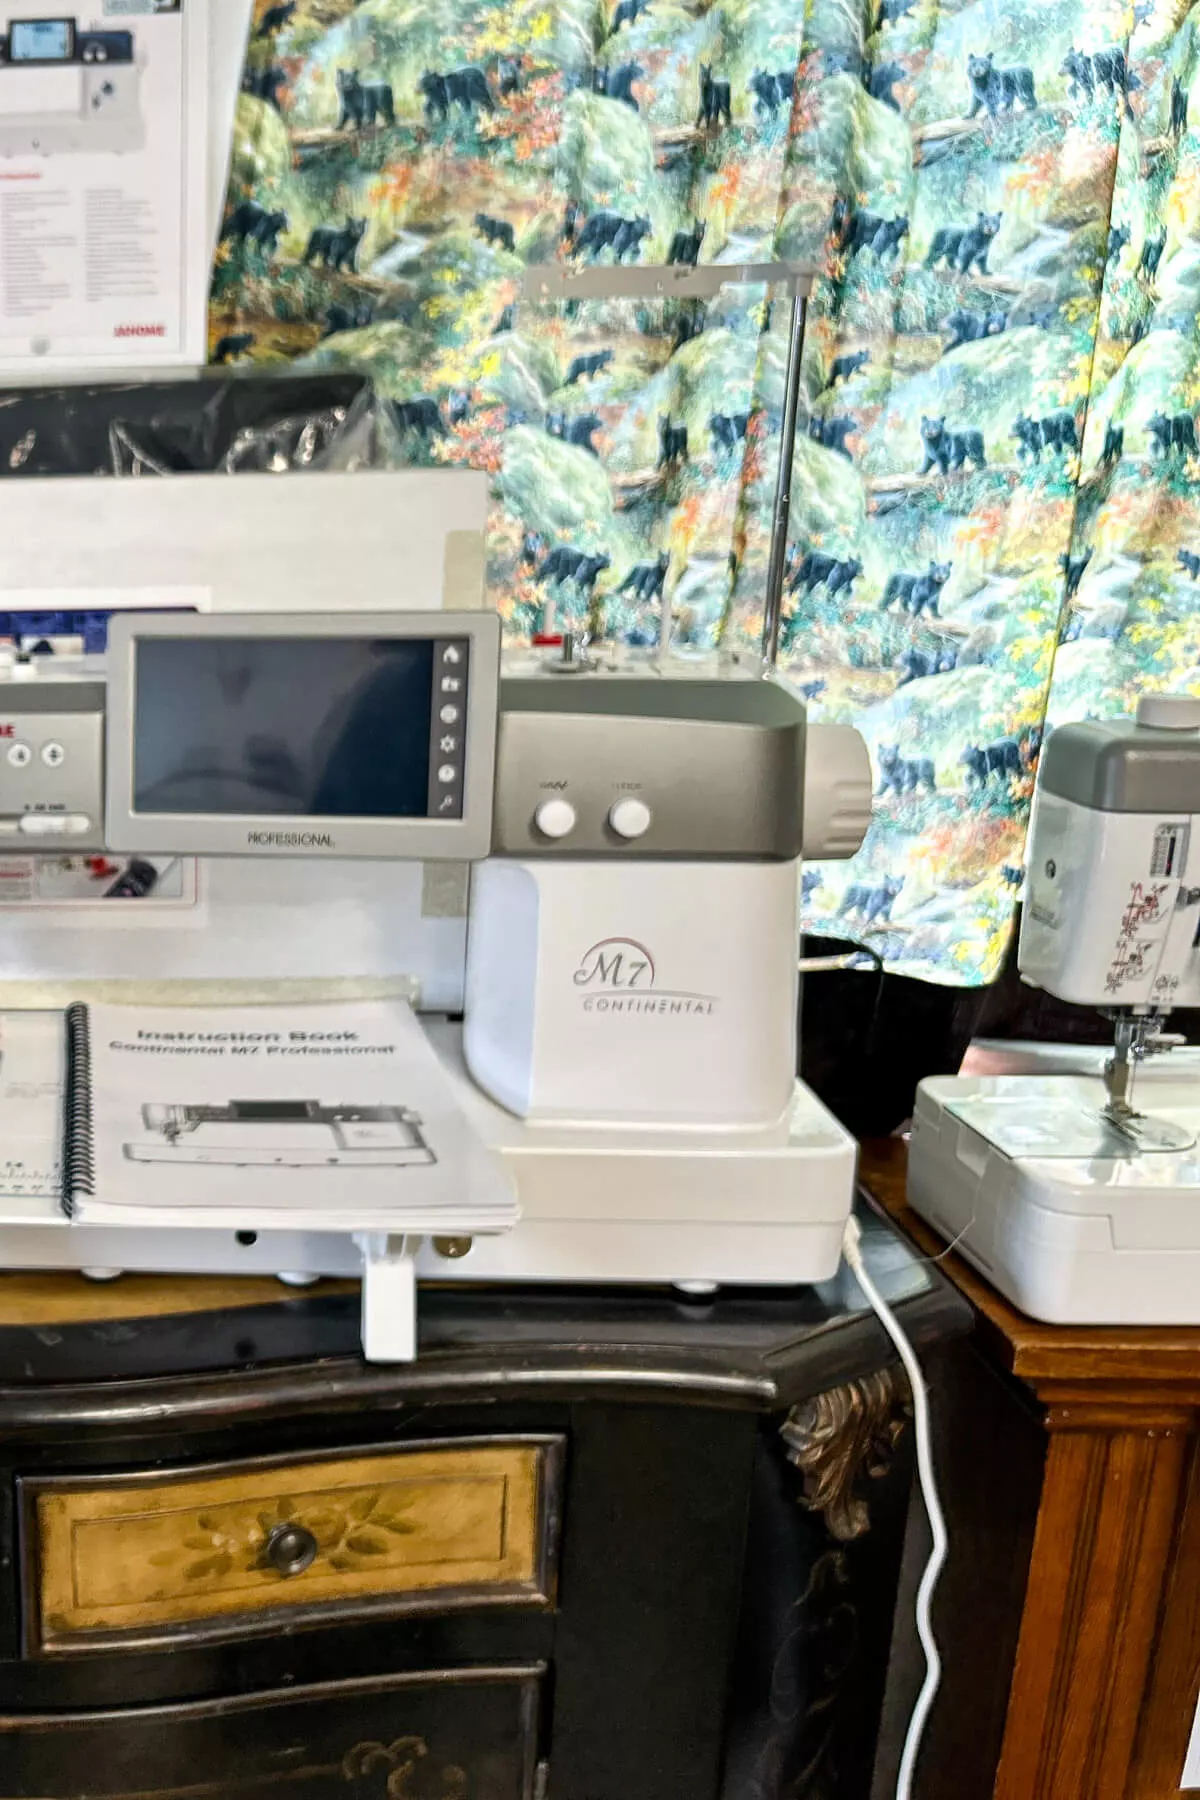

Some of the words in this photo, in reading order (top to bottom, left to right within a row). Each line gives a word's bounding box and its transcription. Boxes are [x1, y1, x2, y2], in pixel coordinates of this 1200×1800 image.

[113, 324, 167, 337] JANOME
[247, 831, 332, 847] PROFESSIONAL
[573, 951, 648, 987] M7
[583, 998, 715, 1015] CONTINENTAL
[137, 1029, 281, 1042] Instruction
[288, 1030, 360, 1042] Book
[108, 1040, 225, 1056] Continental
[266, 1044, 397, 1057] Professional
